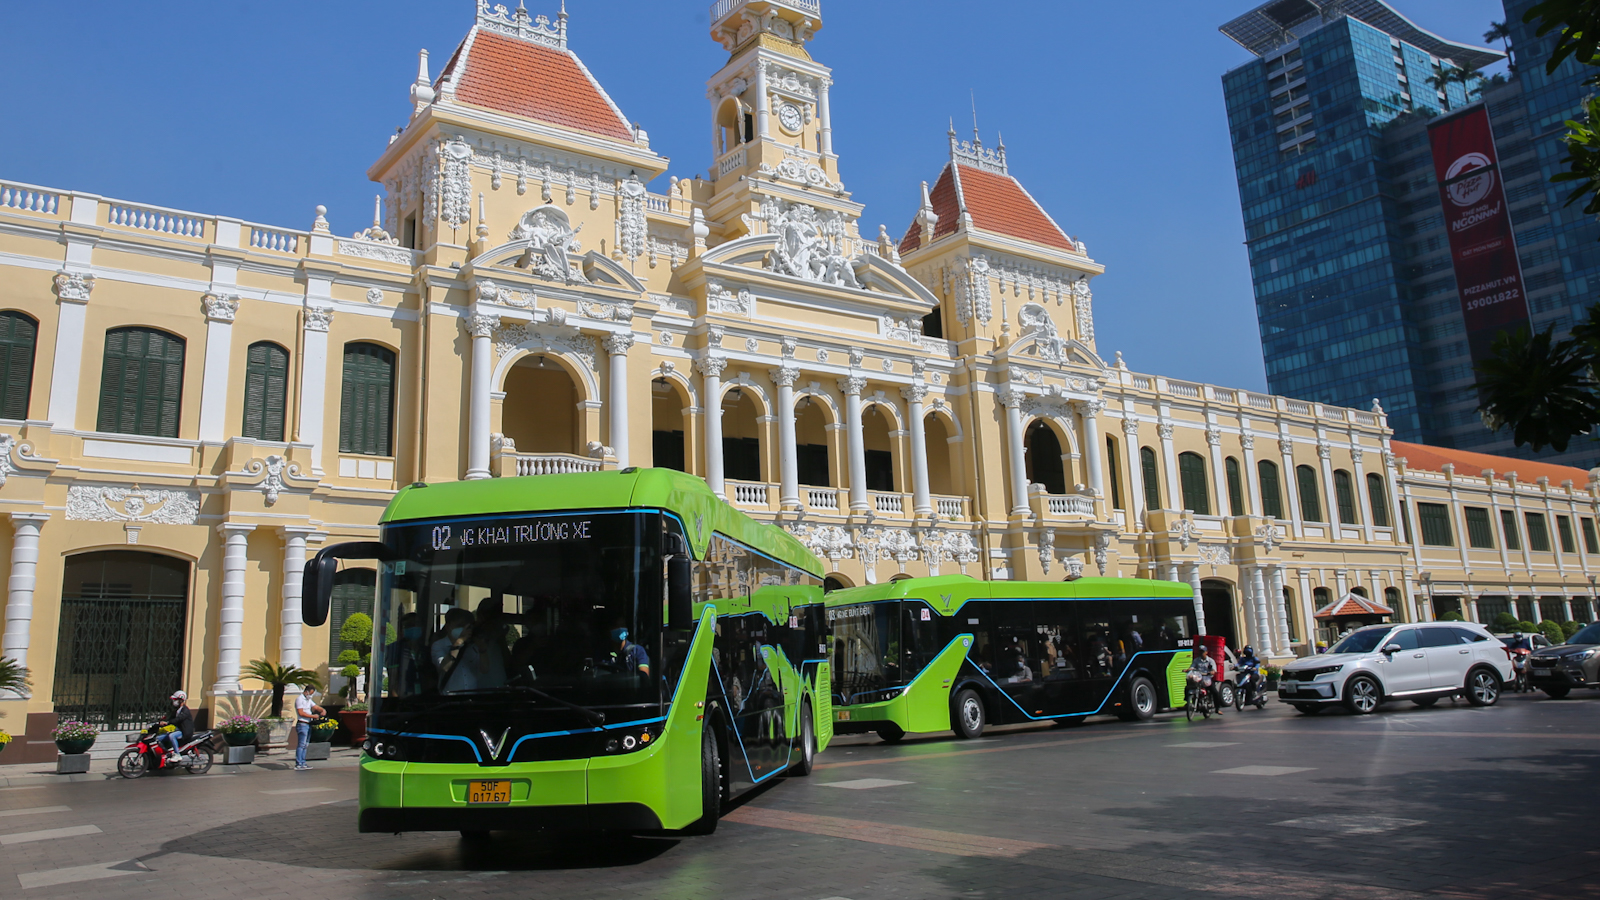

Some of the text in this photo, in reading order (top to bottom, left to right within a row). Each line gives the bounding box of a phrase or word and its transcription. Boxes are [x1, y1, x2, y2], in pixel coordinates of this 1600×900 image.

[1457, 175, 1482, 194] Pizza
[1462, 183, 1481, 198] Hut
[1452, 200, 1500, 231] NGONNN!
[1464, 275, 1516, 296] PIZZAHUT.VN
[1467, 289, 1519, 310] 19001822
[432, 525, 451, 550] 02
[478, 526, 509, 544] KHAI
[513, 521, 568, 542] TRƯƠNG
[572, 521, 591, 539] XE
[481, 781, 499, 791] 50F
[473, 792, 506, 802] 017.67
